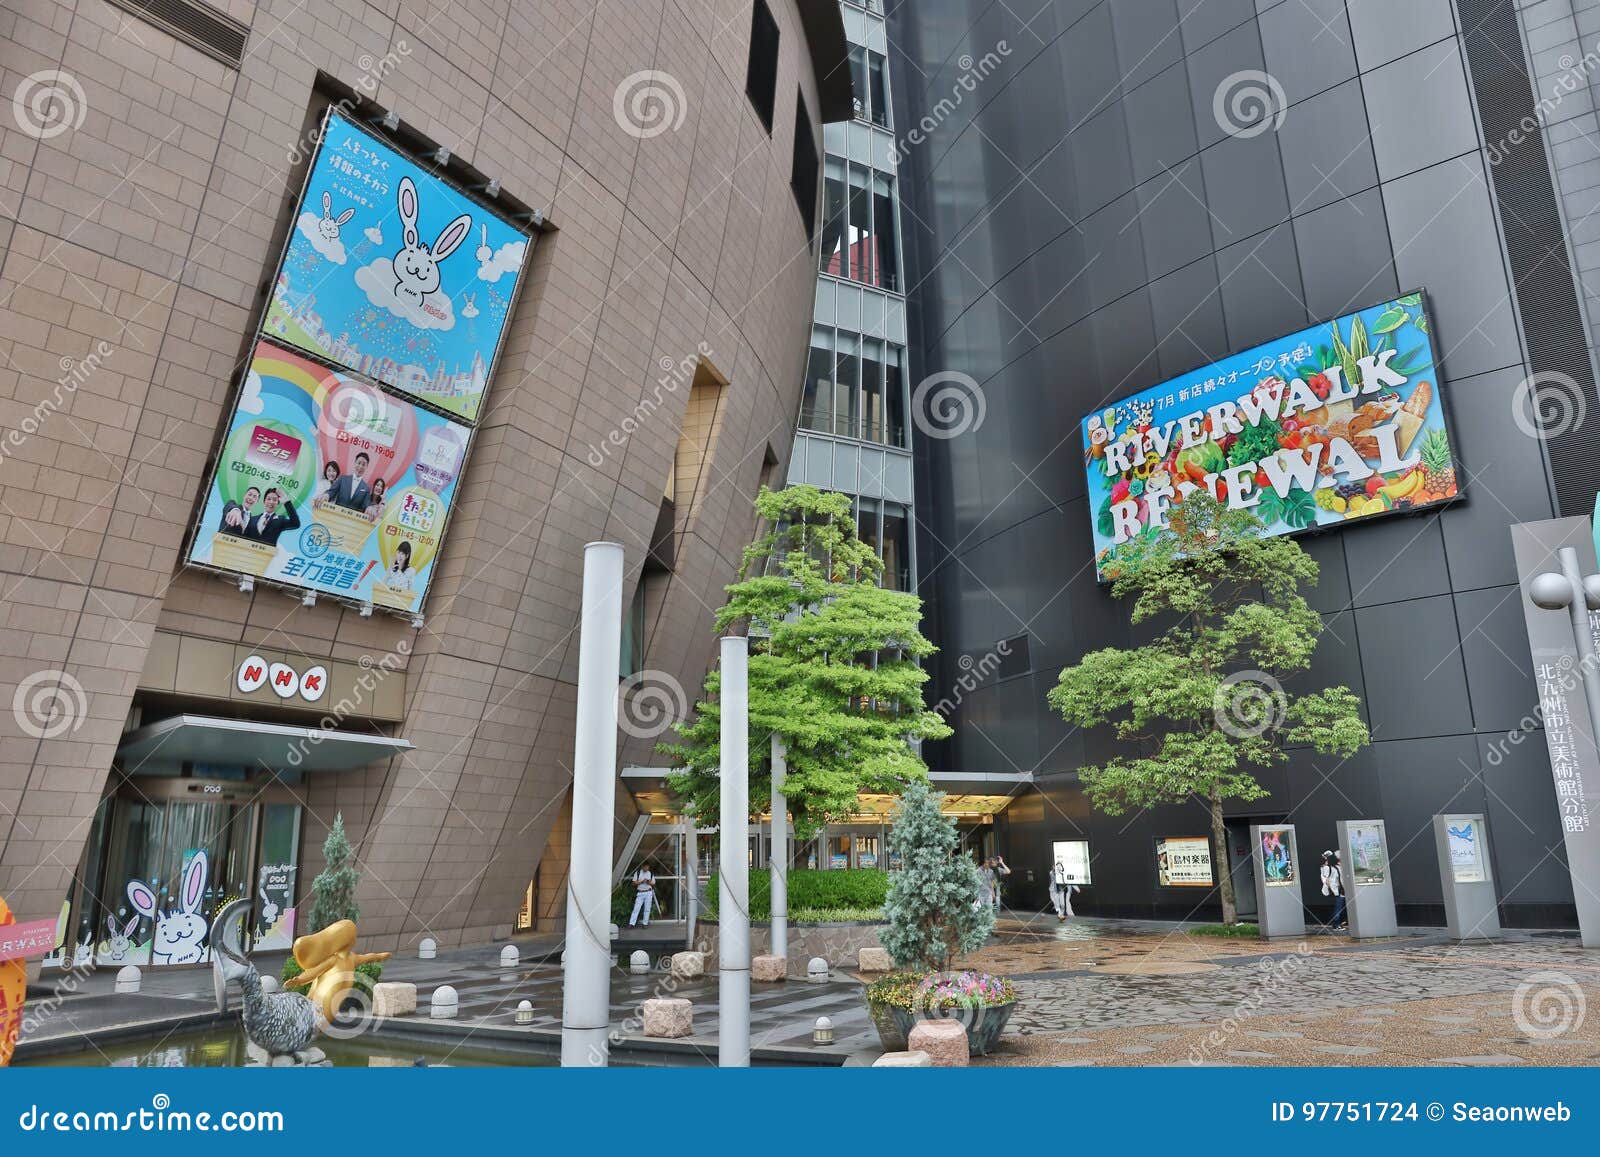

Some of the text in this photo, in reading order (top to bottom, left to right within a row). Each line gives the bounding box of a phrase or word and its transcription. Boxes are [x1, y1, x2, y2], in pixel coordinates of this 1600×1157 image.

[1104, 349, 1407, 478] RIVERWALK
[257, 443, 292, 460] 845
[241, 662, 324, 694] NHK
[1538, 663, 1584, 834] 北九州市立美術館分館
[1173, 853, 1210, 865] 島村楽器
